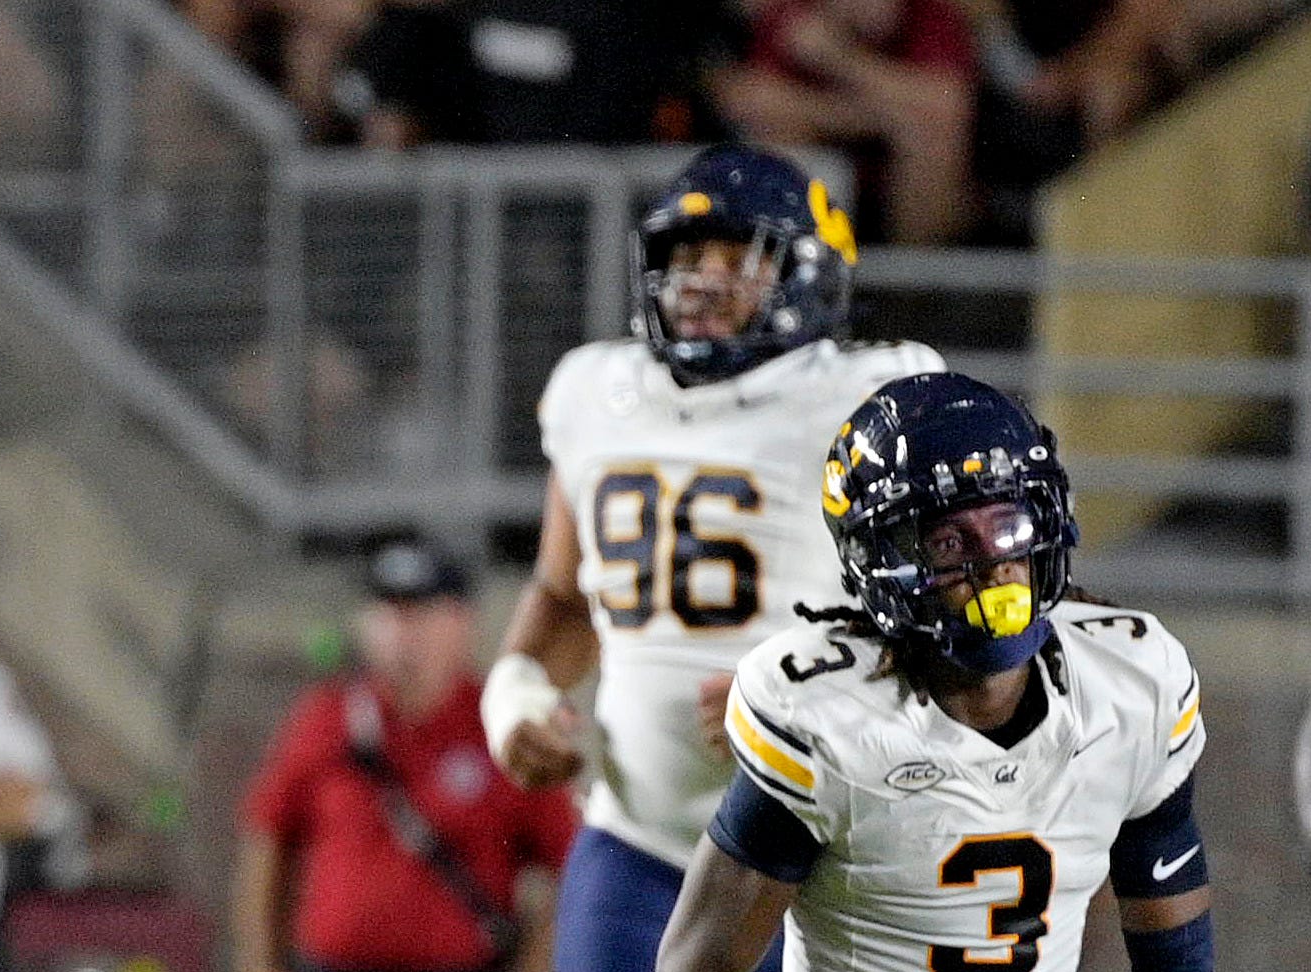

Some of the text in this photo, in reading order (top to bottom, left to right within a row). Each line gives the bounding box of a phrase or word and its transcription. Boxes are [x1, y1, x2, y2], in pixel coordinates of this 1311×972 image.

[594, 461, 764, 632] 96
[779, 638, 857, 683] 3
[894, 766, 936, 782] ACC
